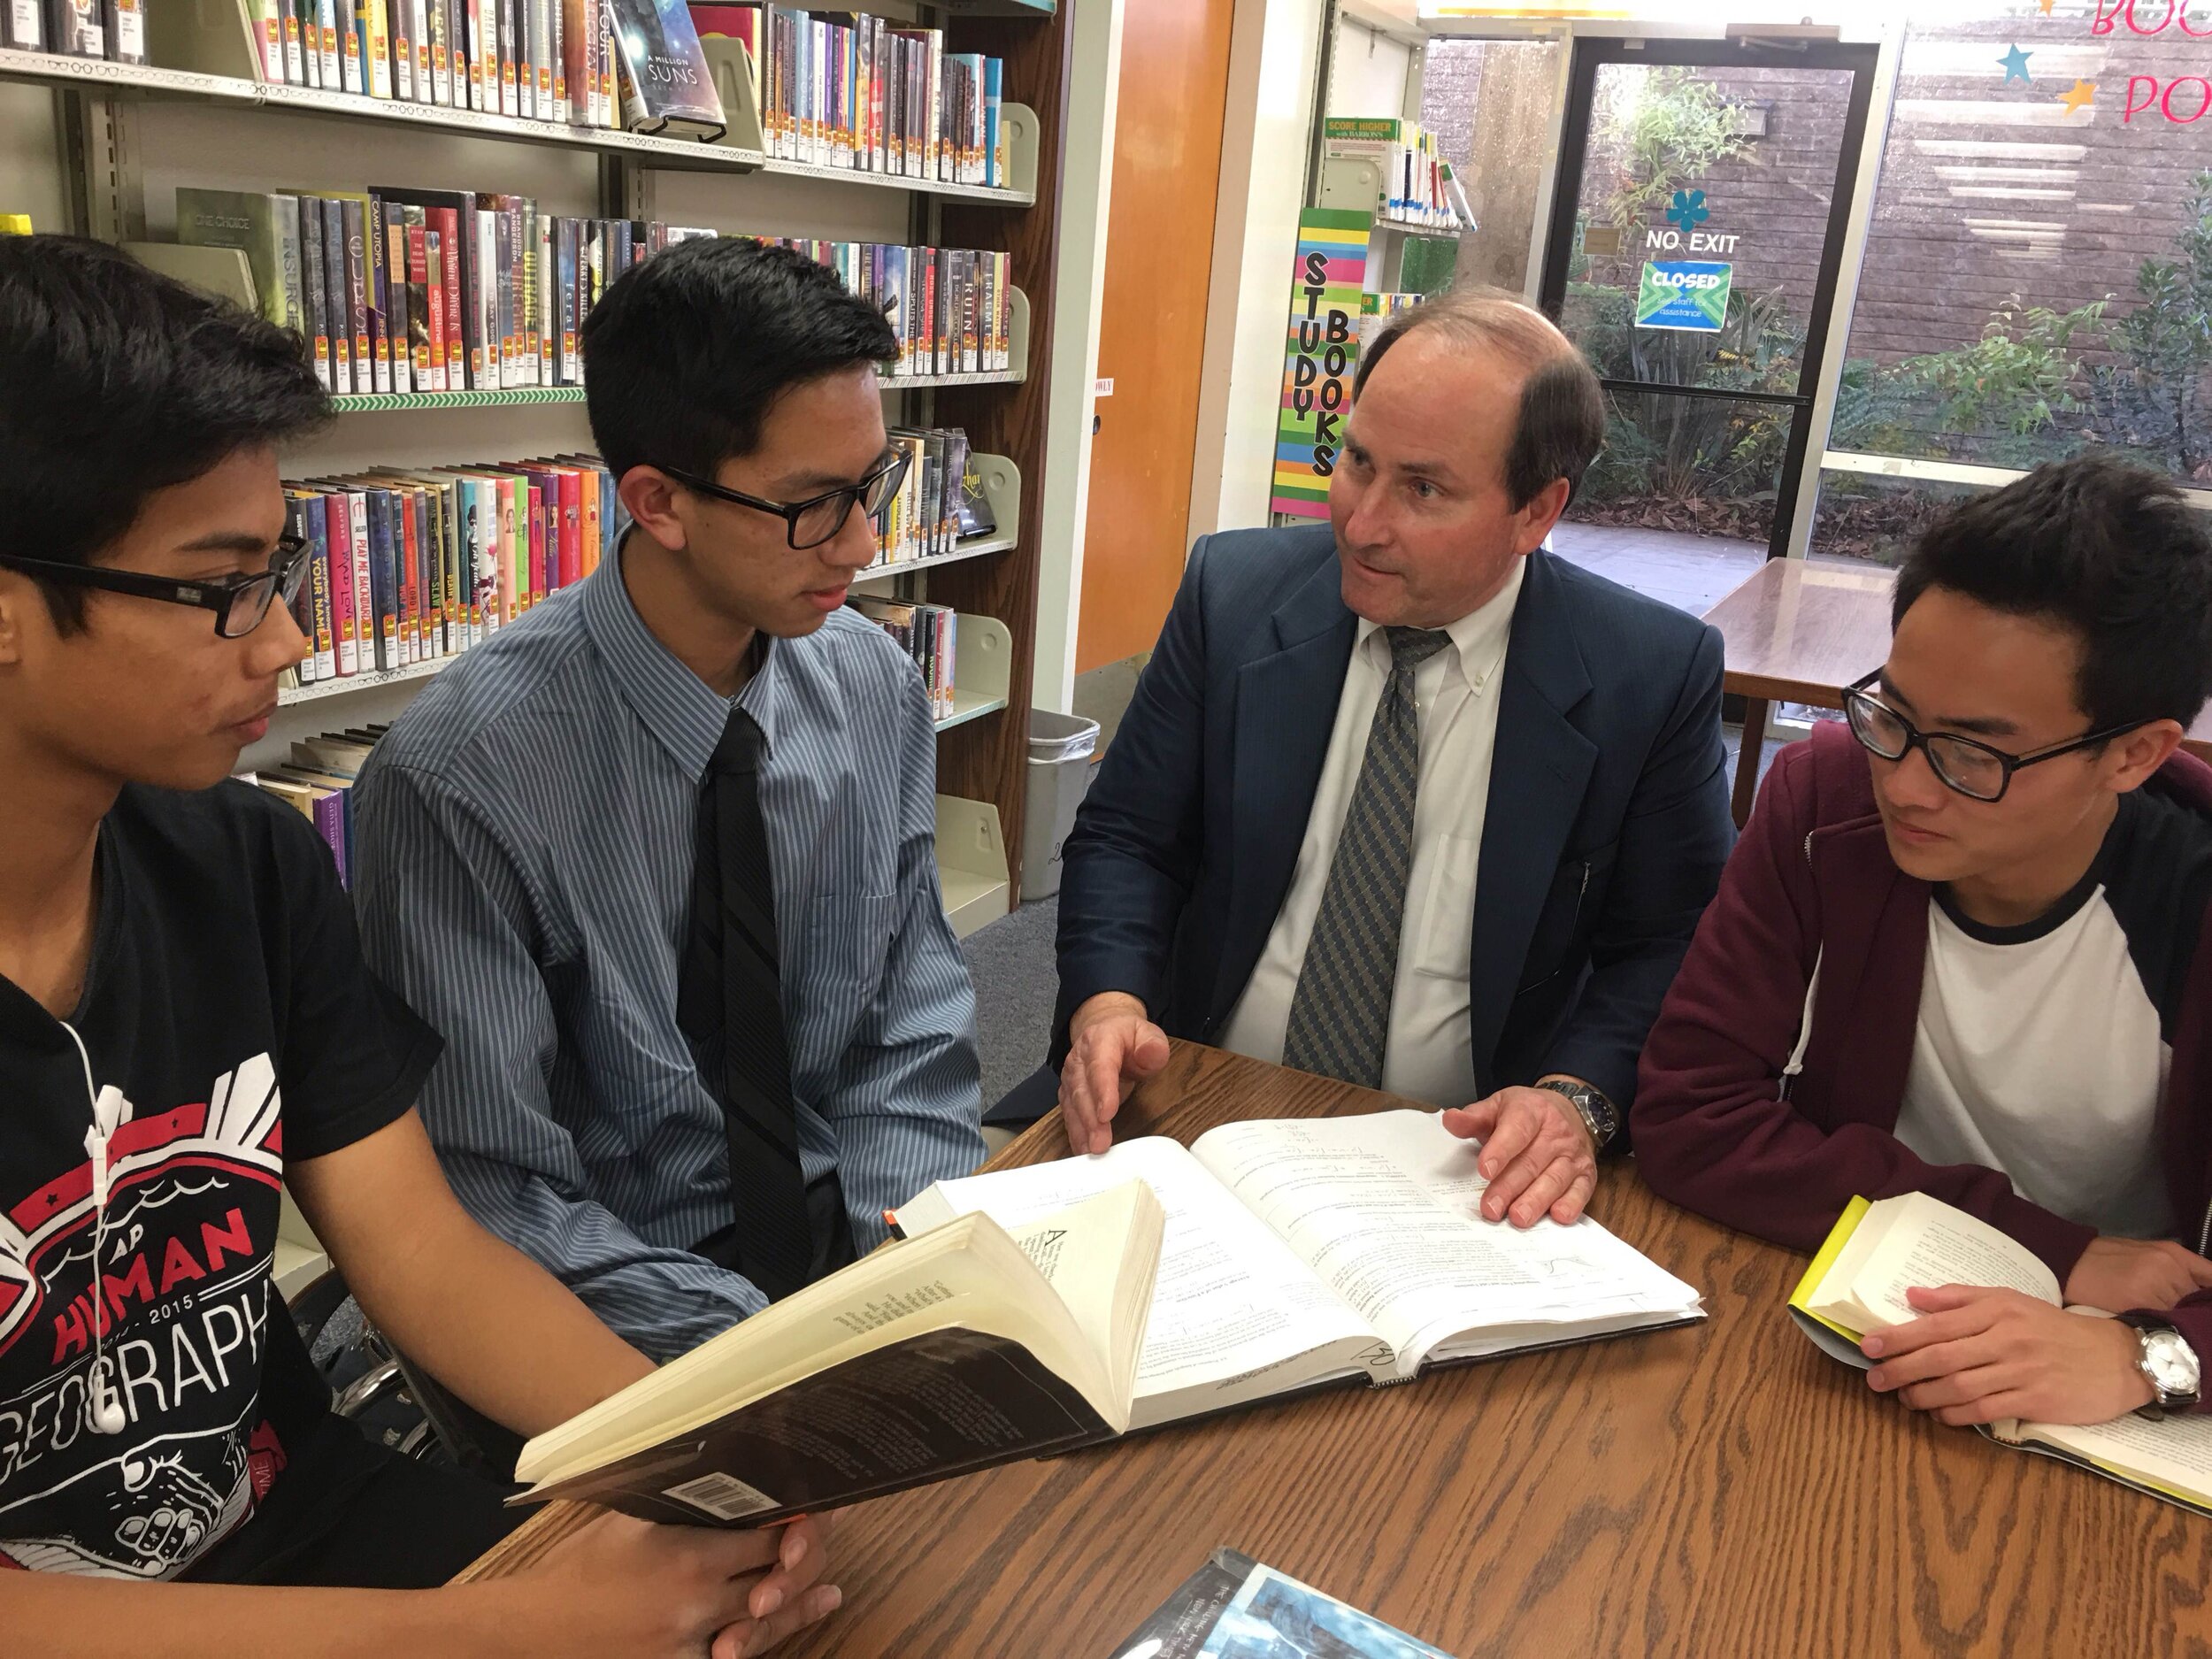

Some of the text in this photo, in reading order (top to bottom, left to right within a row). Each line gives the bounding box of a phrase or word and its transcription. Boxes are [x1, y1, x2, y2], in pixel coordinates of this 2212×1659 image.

[648, 64, 697, 85] SUNS
[655, 56, 688, 66] MILLION
[2124, 75, 2212, 124] PO
[1329, 121, 1391, 132] SCORE HIGHER
[372, 201, 382, 269] CAMP UTOPIA
[1646, 230, 1740, 254] NO EXIT
[524, 250, 538, 326] OUTRAGE
[1651, 272, 1721, 289] CLOSED
[431, 289, 443, 344] augustine
[565, 283, 576, 333] feral
[964, 282, 973, 331] RUIN
[1659, 309, 1702, 318] assistance
[1672, 297, 1694, 306] staff
[1292, 251, 1329, 422] STUDY
[1311, 309, 1350, 478] BOOKS
[357, 539, 368, 559] PLAY
[312, 557, 323, 595] YOUR
[321, 556, 331, 603] everybody
[337, 550, 350, 586] MAD
[357, 561, 369, 574] ME
[409, 586, 418, 606] LORD
[432, 581, 441, 607] SLAW
[109, 1224, 143, 1265] AP
[51, 1208, 254, 1365] HUMAN
[149, 1295, 193, 1324] 2015
[1215, 1586, 1230, 1600] THE
[1194, 1600, 1219, 1632] CHILLING
